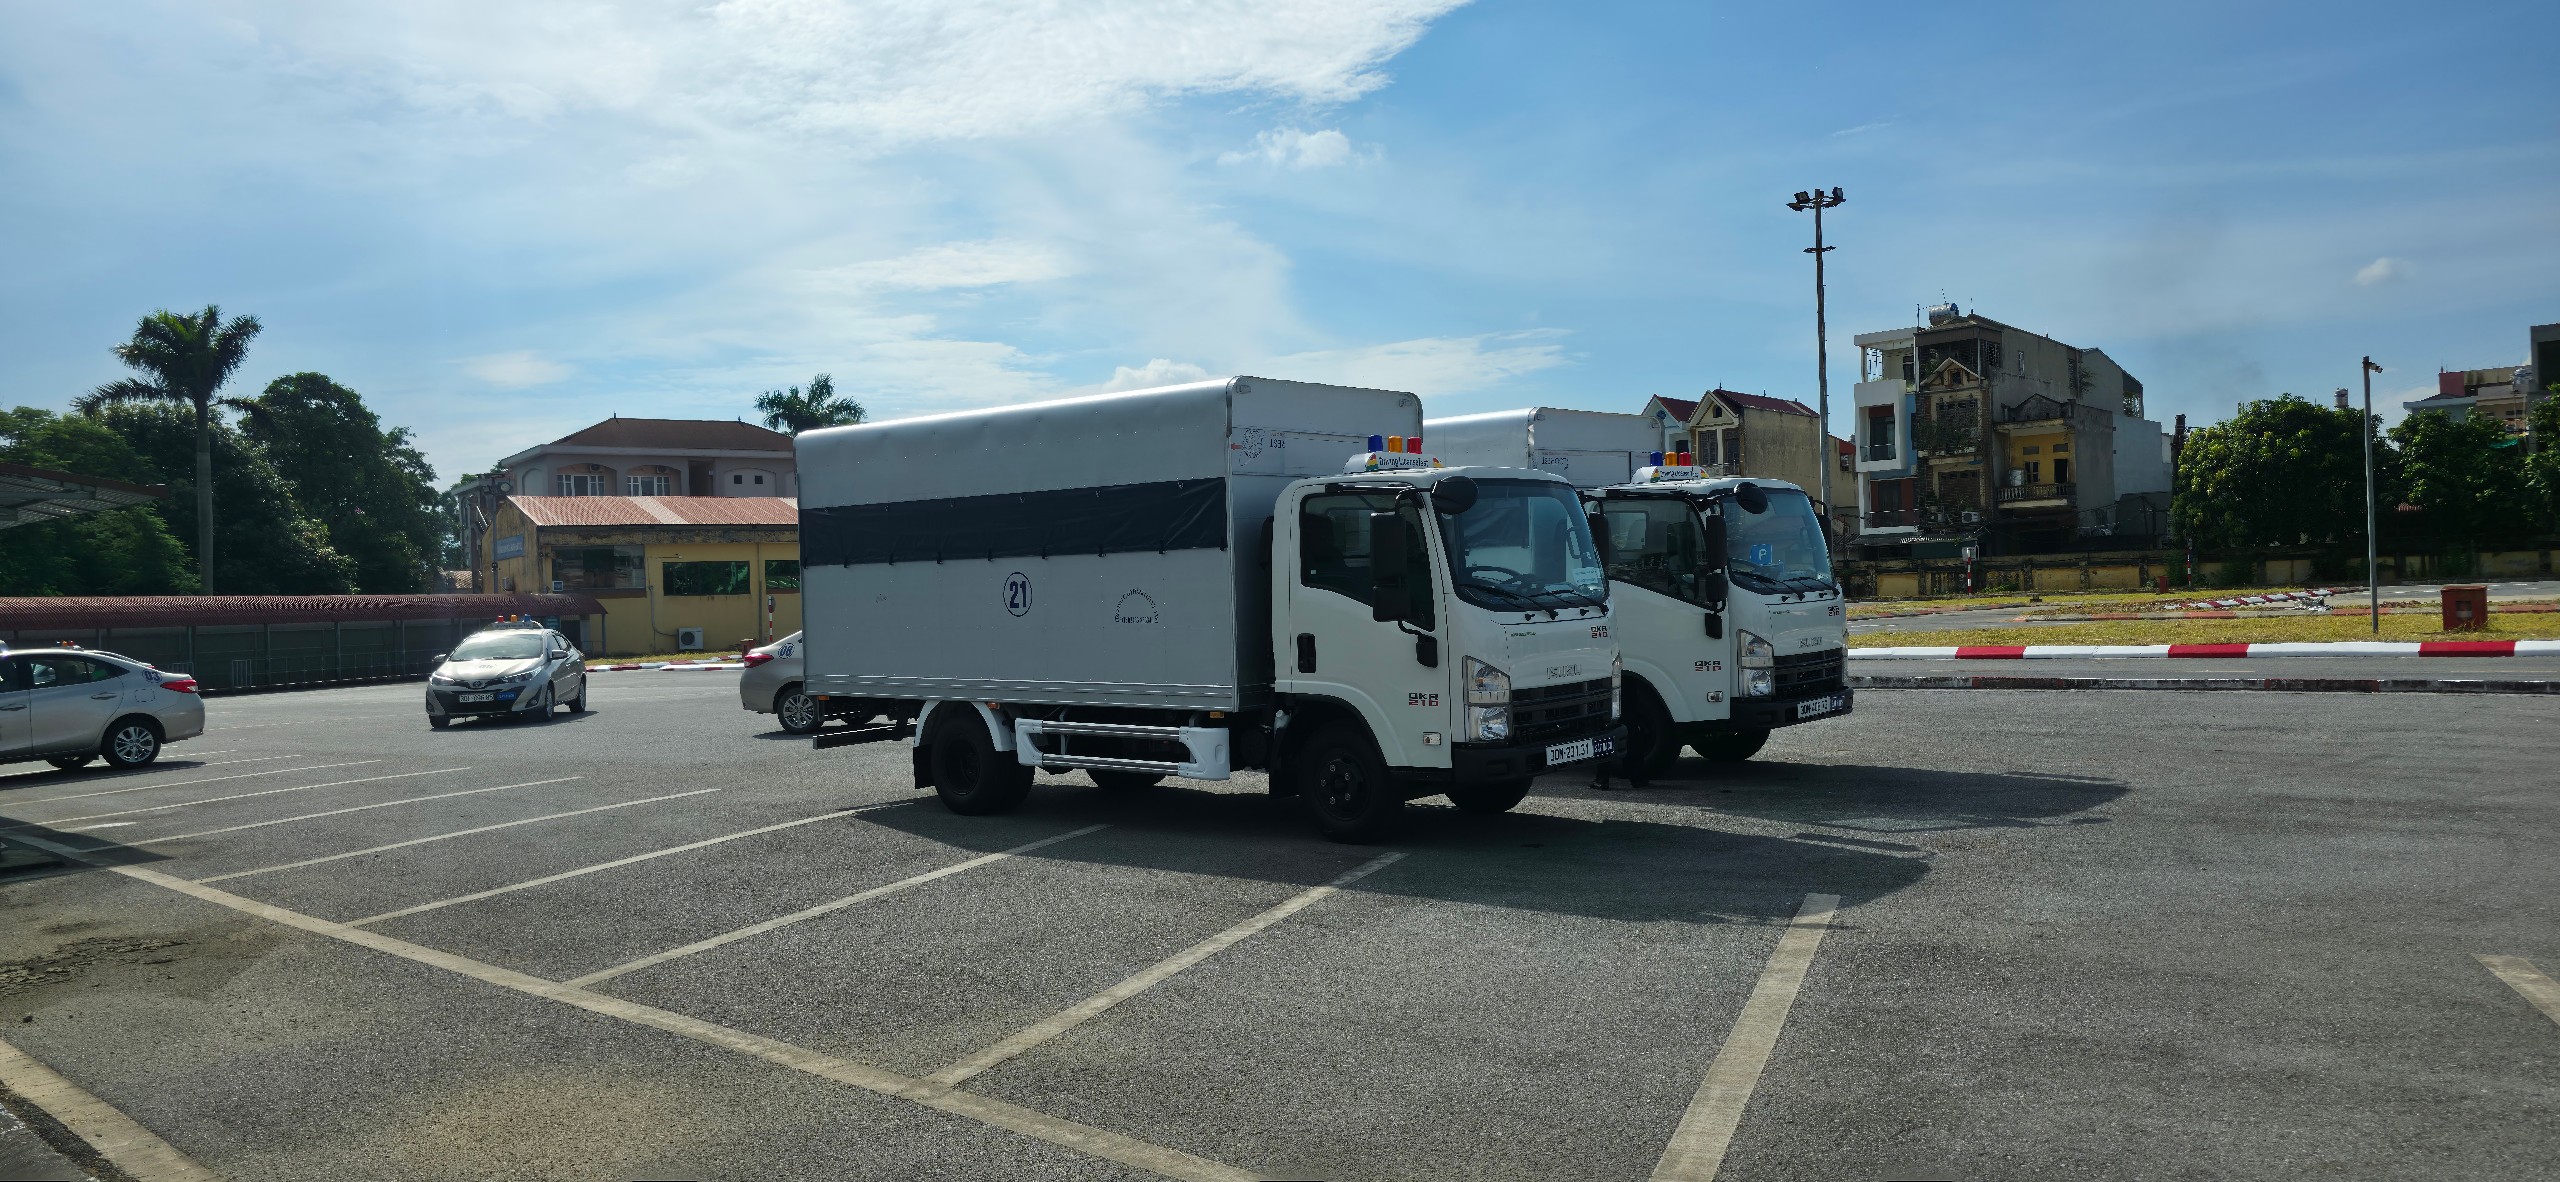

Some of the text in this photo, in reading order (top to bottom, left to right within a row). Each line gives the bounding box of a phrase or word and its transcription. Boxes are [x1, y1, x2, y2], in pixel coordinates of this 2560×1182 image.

[1759, 548, 1767, 560] P
[1010, 581, 1027, 608] 21
[780, 645, 793, 656] 08
[144, 671, 160, 681] 03
[1546, 664, 1582, 679] ISUZU
[1408, 692, 1439, 700] QKR
